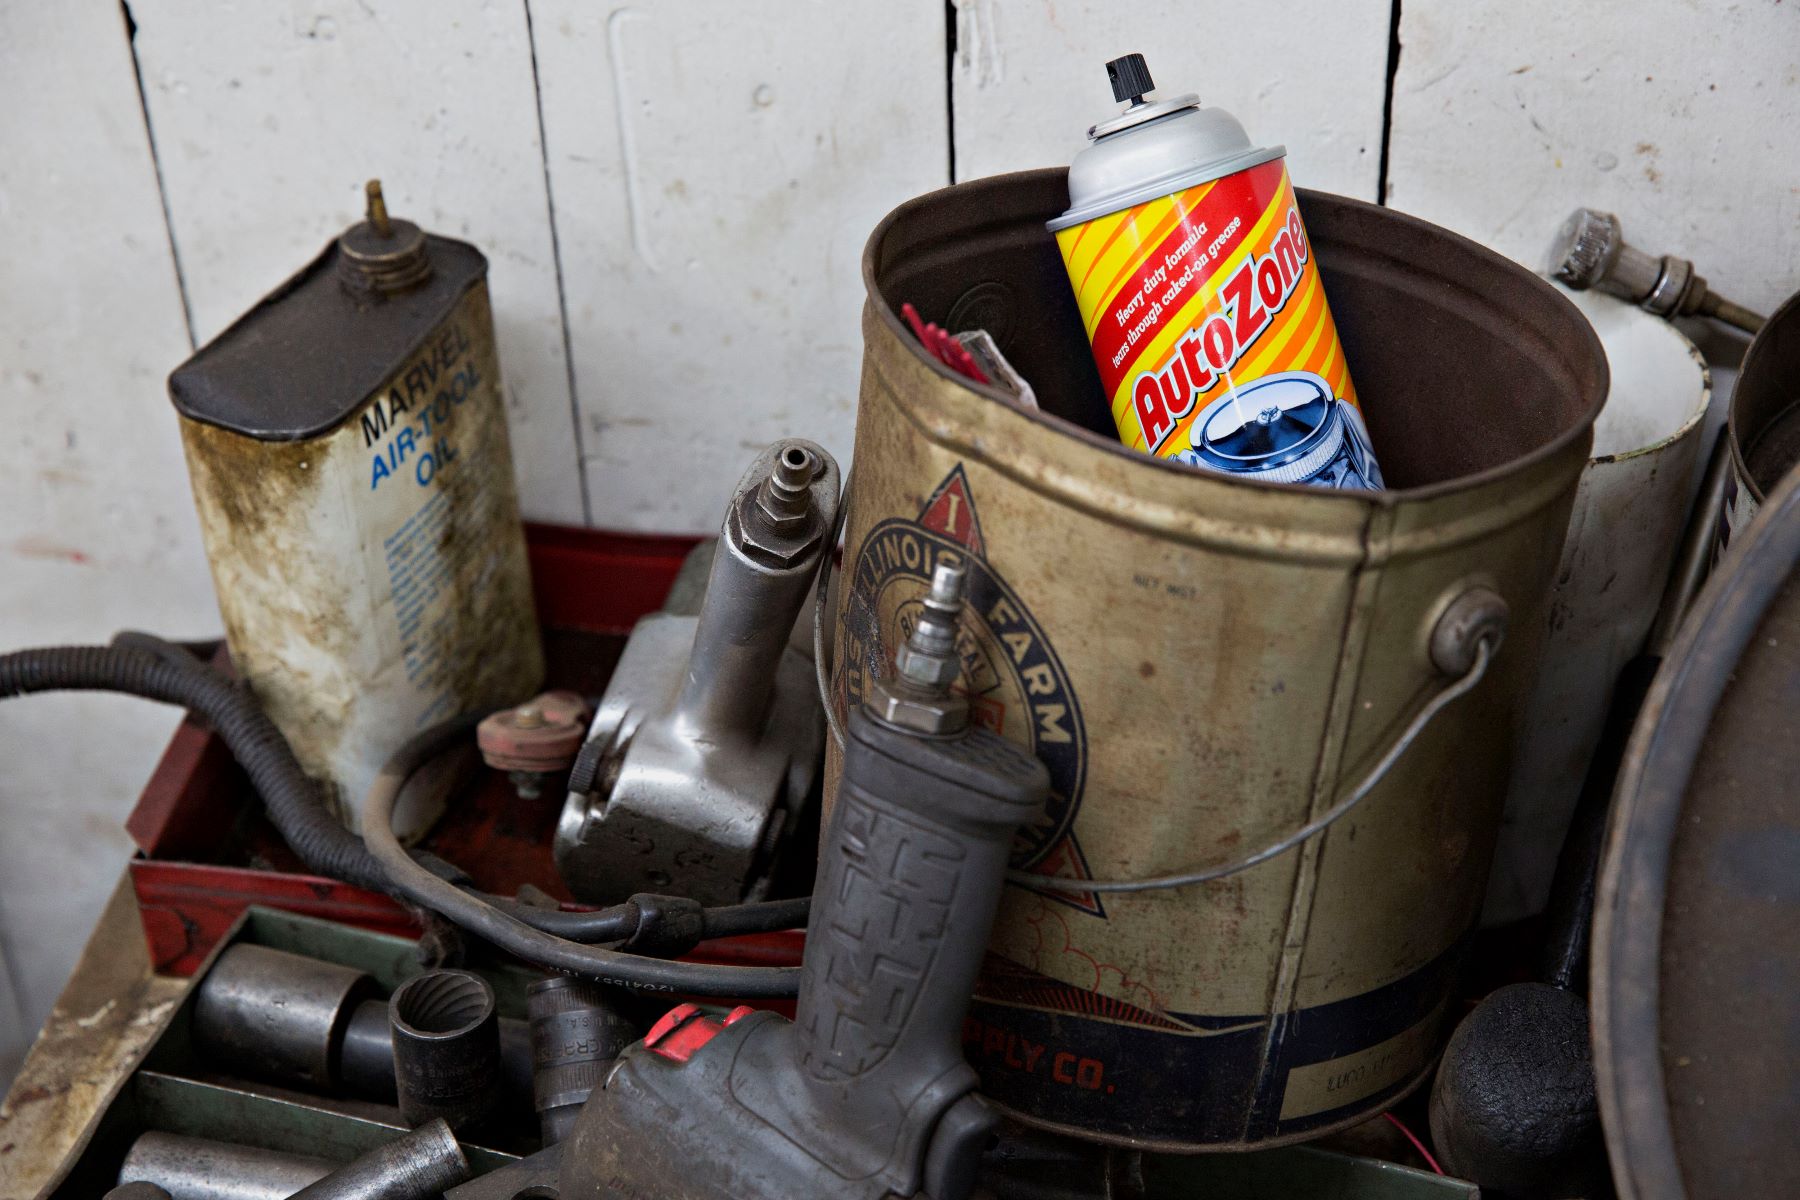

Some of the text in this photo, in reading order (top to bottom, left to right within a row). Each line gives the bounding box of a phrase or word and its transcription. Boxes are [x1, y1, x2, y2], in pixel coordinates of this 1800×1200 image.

[1112, 216, 1241, 369] tears through caked-on grease
[1115, 221, 1208, 327] Heavy duty formula
[1132, 208, 1307, 451] AutoZone
[361, 325, 470, 449] MARVEL
[371, 361, 481, 490] AIR-TOOL
[416, 437, 458, 487] OIL
[988, 598, 1073, 744] FARM
[962, 1015, 1116, 1095] PPLY CO.
